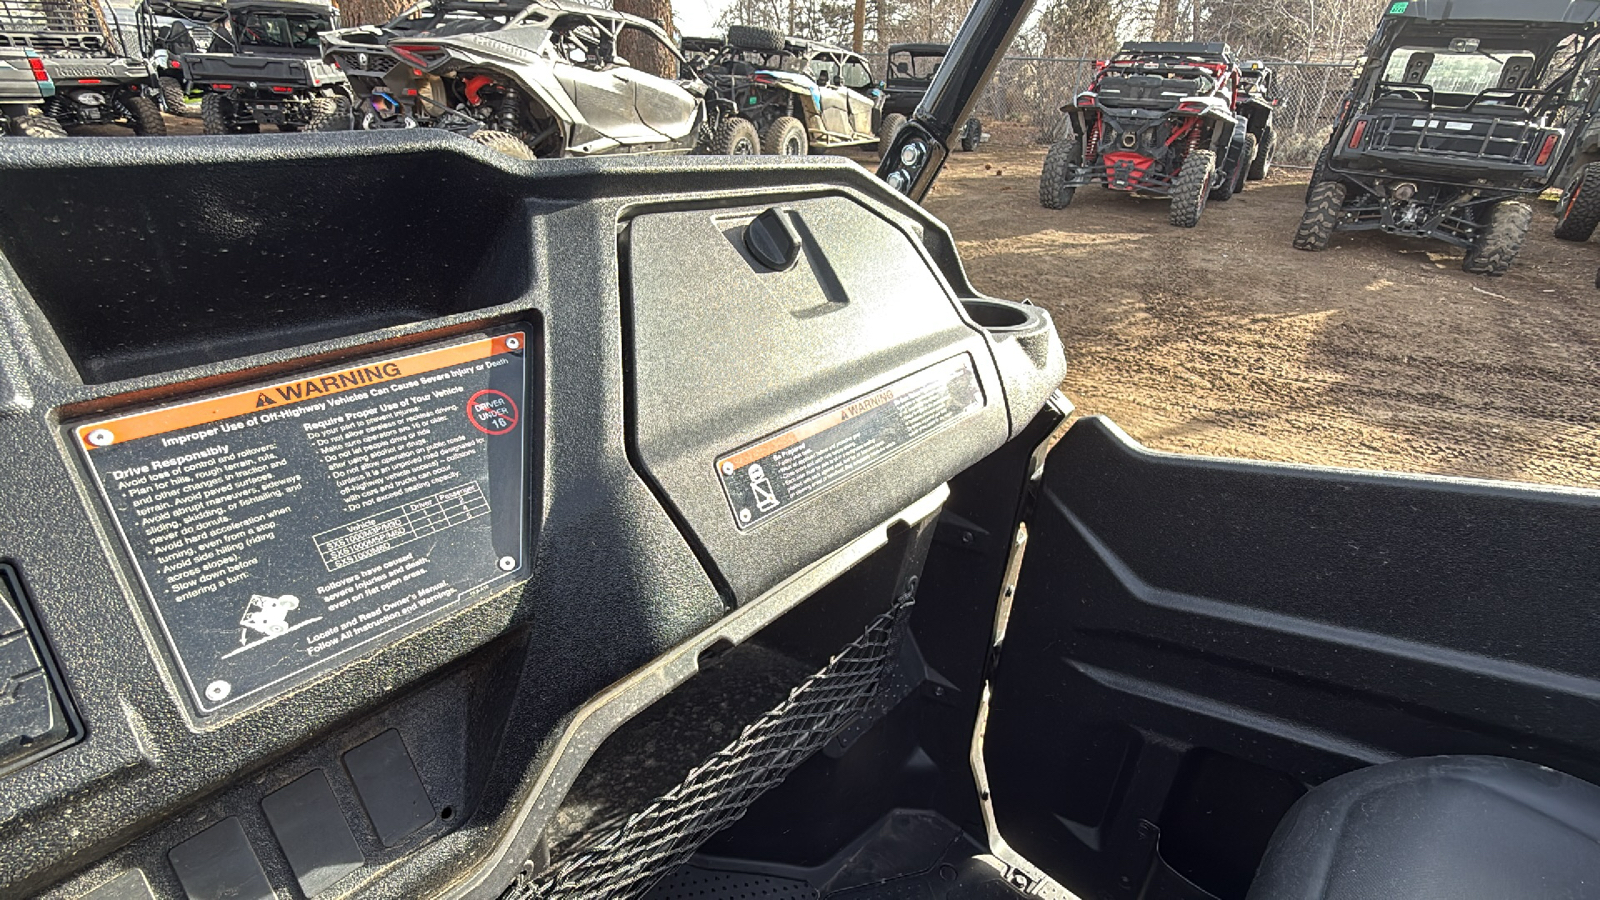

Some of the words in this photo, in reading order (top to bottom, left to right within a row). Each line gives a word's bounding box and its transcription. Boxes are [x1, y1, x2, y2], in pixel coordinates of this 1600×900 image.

[55, 65, 117, 77] Kawasaki
[275, 363, 401, 400] WARNING
[162, 428, 218, 447] Improper
[220, 422, 245, 432] Use
[260, 403, 325, 423] Off-Highway
[326, 393, 369, 407] Vehicles
[370, 388, 389, 396] Can
[390, 380, 419, 391] Cause
[421, 373, 450, 384] Severe
[450, 367, 474, 377] Injury
[486, 358, 508, 368] Death
[303, 416, 344, 431] Require
[345, 408, 378, 420] Proper
[379, 403, 398, 411] Use
[410, 394, 430, 403] Your
[432, 386, 463, 398] Vehicle
[475, 398, 505, 412] DRIVER
[478, 408, 508, 420] UNDER
[849, 390, 893, 416] WARNING
[320, 445, 343, 453] Make
[321, 428, 338, 437] your
[330, 434, 343, 442] not
[345, 430, 364, 438] allow
[338, 450, 351, 458] not
[363, 441, 388, 452] people
[390, 435, 407, 443] drive
[112, 466, 149, 480] Drive
[151, 445, 228, 470] Responsibly
[119, 476, 147, 490] Avoid
[148, 471, 170, 481] loss
[184, 458, 216, 472] control
[218, 453, 235, 463] and
[328, 461, 345, 470] after
[348, 455, 369, 465] using
[370, 447, 396, 458] alcohol
[346, 466, 359, 474] not
[361, 461, 379, 470] allow
[381, 451, 415, 464] operation
[426, 441, 446, 452] public
[128, 487, 153, 497] Plan
[155, 482, 168, 490] for
[195, 467, 223, 479] rough
[133, 495, 153, 507] and
[155, 489, 180, 500] other
[183, 477, 223, 492] changes
[235, 465, 268, 477] traction
[270, 458, 287, 468] and
[136, 502, 173, 516] terrain.
[175, 492, 202, 505] Avoid
[203, 483, 233, 498] paved
[235, 473, 275, 488] surfaces.
[343, 494, 360, 503] with
[380, 482, 394, 492] and
[395, 477, 417, 487] trucks
[362, 498, 375, 507] not
[376, 488, 403, 502] exceed
[142, 512, 170, 526] Avoid
[173, 502, 205, 516] abrupt
[205, 488, 260, 506] maneuvers,
[261, 475, 301, 490] sideways
[145, 521, 182, 535] sliding,
[183, 507, 226, 524] skidding,
[285, 483, 302, 492] and
[347, 520, 376, 532] Vehicle
[410, 500, 432, 511] Driver
[149, 532, 178, 545] never
[196, 517, 232, 530] donuts.
[155, 540, 183, 554] Avoid
[184, 532, 208, 544] hard
[210, 515, 265, 537] acceleration
[267, 507, 291, 518] when
[158, 548, 197, 563] turning,
[198, 539, 222, 550] even
[223, 532, 246, 541] from
[163, 558, 192, 573] Avoid
[193, 552, 214, 563] side
[215, 542, 244, 555] hilling
[246, 532, 275, 546] (riding
[167, 568, 201, 583] across
[202, 554, 240, 570] slopes).
[172, 580, 197, 592] Slow
[199, 570, 226, 582] down
[227, 558, 258, 572] before
[317, 575, 360, 594] Rollovers
[361, 566, 382, 577] have
[383, 552, 413, 568] caused
[324, 587, 354, 602] severe
[355, 574, 387, 590] injuries
[388, 566, 404, 577] and
[175, 583, 217, 602] entering
[328, 598, 350, 611] even
[365, 586, 380, 596] flat
[381, 578, 402, 590] open
[307, 626, 339, 644] Locate
[340, 617, 358, 630] and
[358, 607, 382, 622] Read
[383, 594, 417, 612] Owner's
[418, 580, 448, 597] Manual.
[307, 638, 339, 654] Follow
[341, 630, 353, 640] All
[353, 611, 401, 634] Instruction
[402, 602, 417, 614] and
